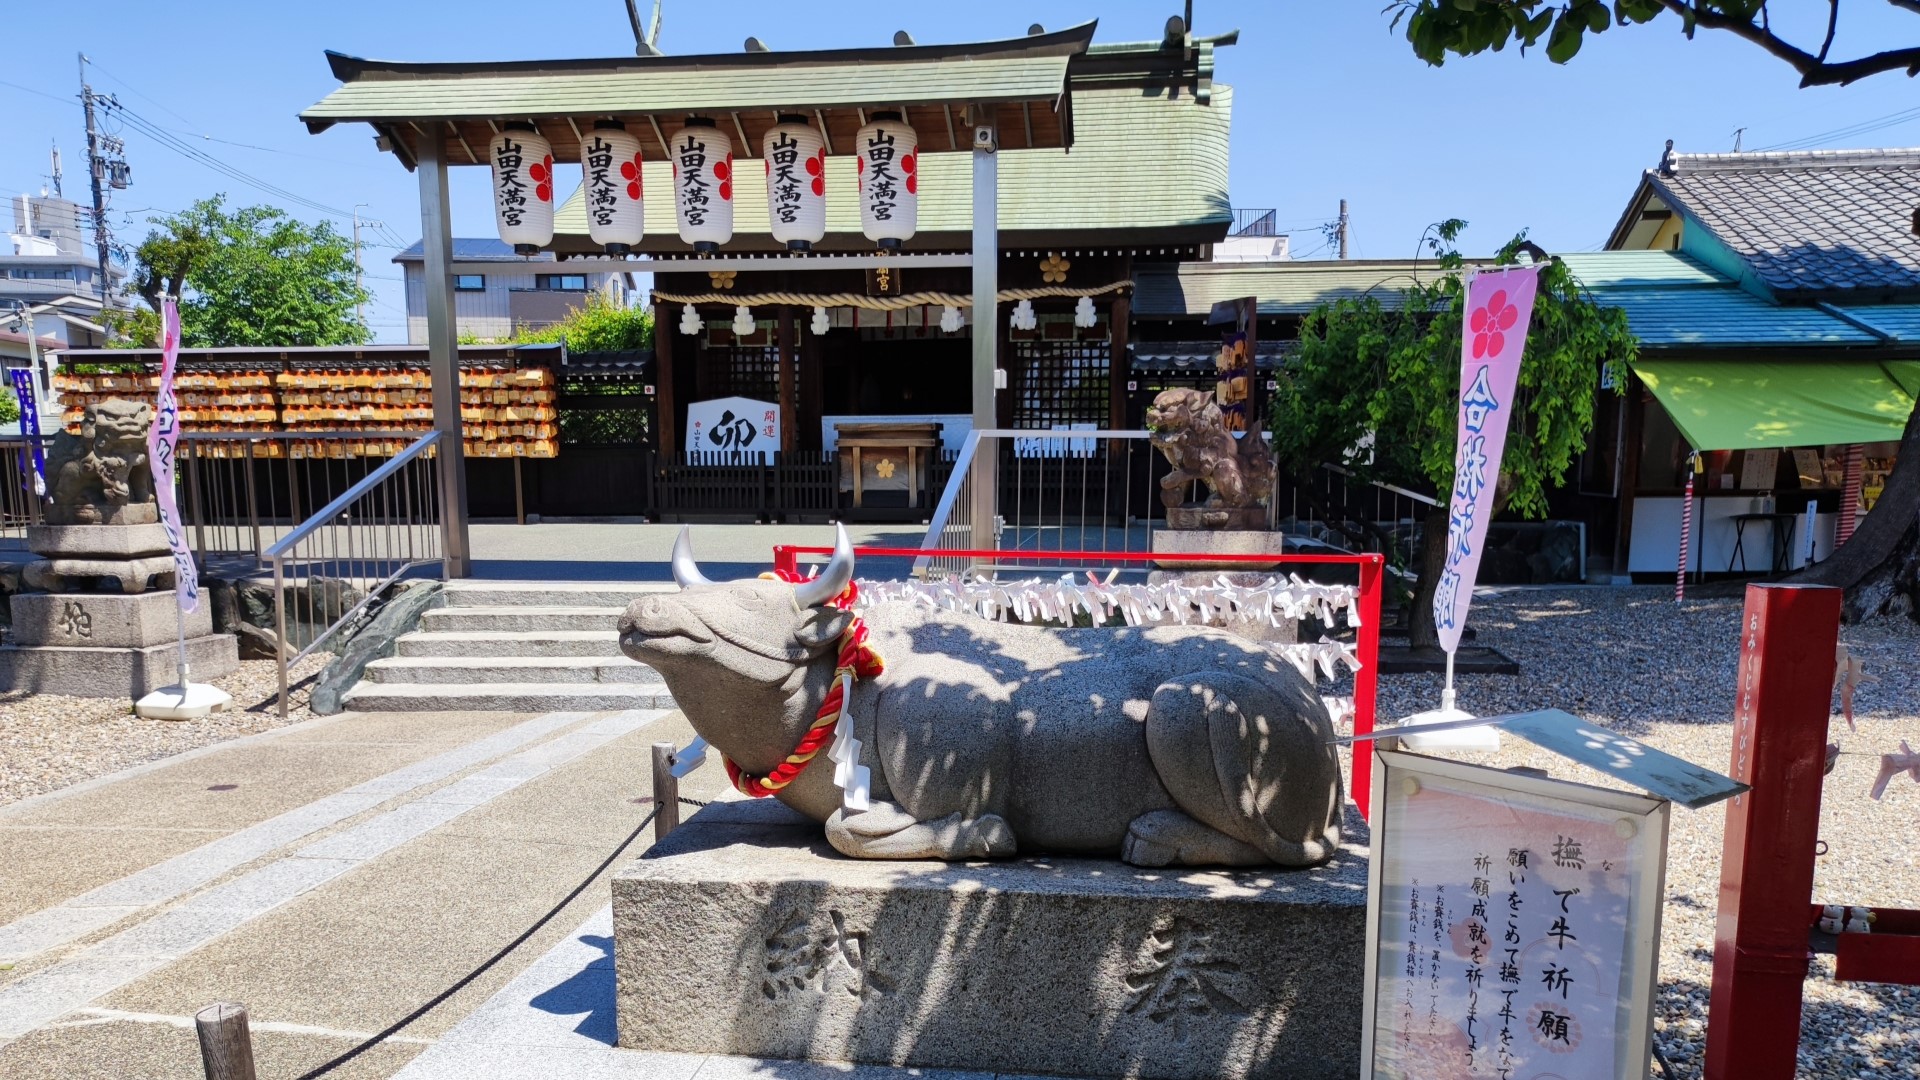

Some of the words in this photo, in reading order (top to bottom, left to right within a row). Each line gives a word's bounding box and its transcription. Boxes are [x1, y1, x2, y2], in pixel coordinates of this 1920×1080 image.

[496, 136, 528, 227] 山田天満宮
[587, 136, 618, 226] 山田天満宮
[679, 134, 711, 226] 山田天満宮
[771, 131, 802, 223] 山田天満宮
[867, 128, 900, 221] 山田天満宮
[708, 409, 758, 462] 卯
[762, 409, 775, 438] 開運
[1465, 852, 1492, 1072] 祈願成就を祈りましょう。
[1536, 834, 1587, 1046] 撫で牛祈願
